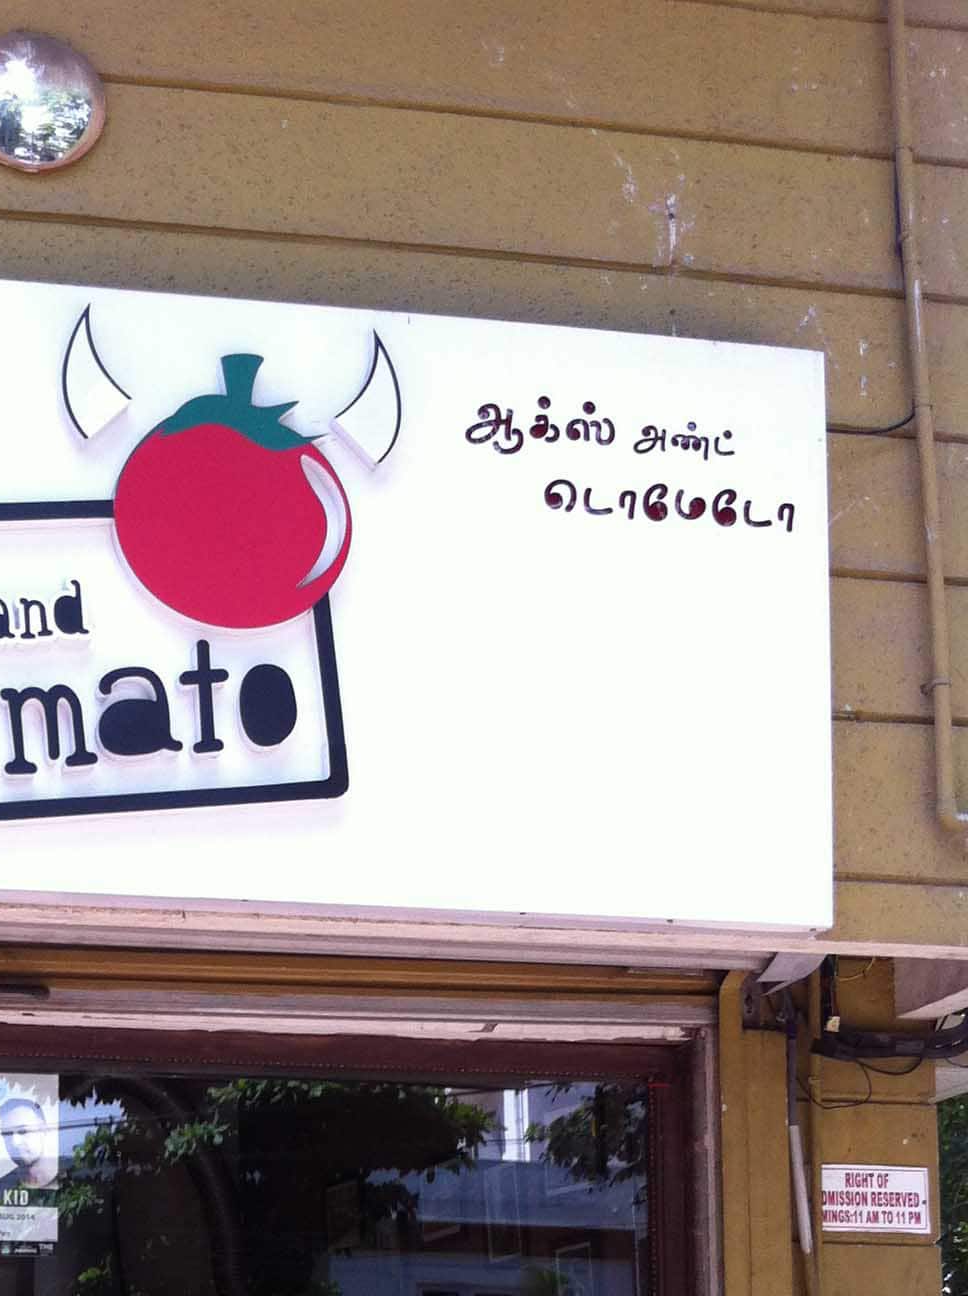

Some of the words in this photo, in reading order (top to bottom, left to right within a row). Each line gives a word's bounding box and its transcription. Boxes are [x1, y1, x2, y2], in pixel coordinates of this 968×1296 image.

[465, 396, 616, 455] ஆக்ஸ்
[633, 421, 735, 461] அண்ட்
[544, 479, 795, 533] டொமேடோ
[845, 1172, 874, 1188] RIGHT
[877, 1173, 889, 1188] OF
[3, 1189, 29, 1206] KID
[870, 1192, 920, 1208] RESERVED
[866, 1211, 879, 1224] AM
[881, 1211, 893, 1224] TO
[896, 1211, 905, 1224] 11
[908, 1211, 922, 1225] PM
